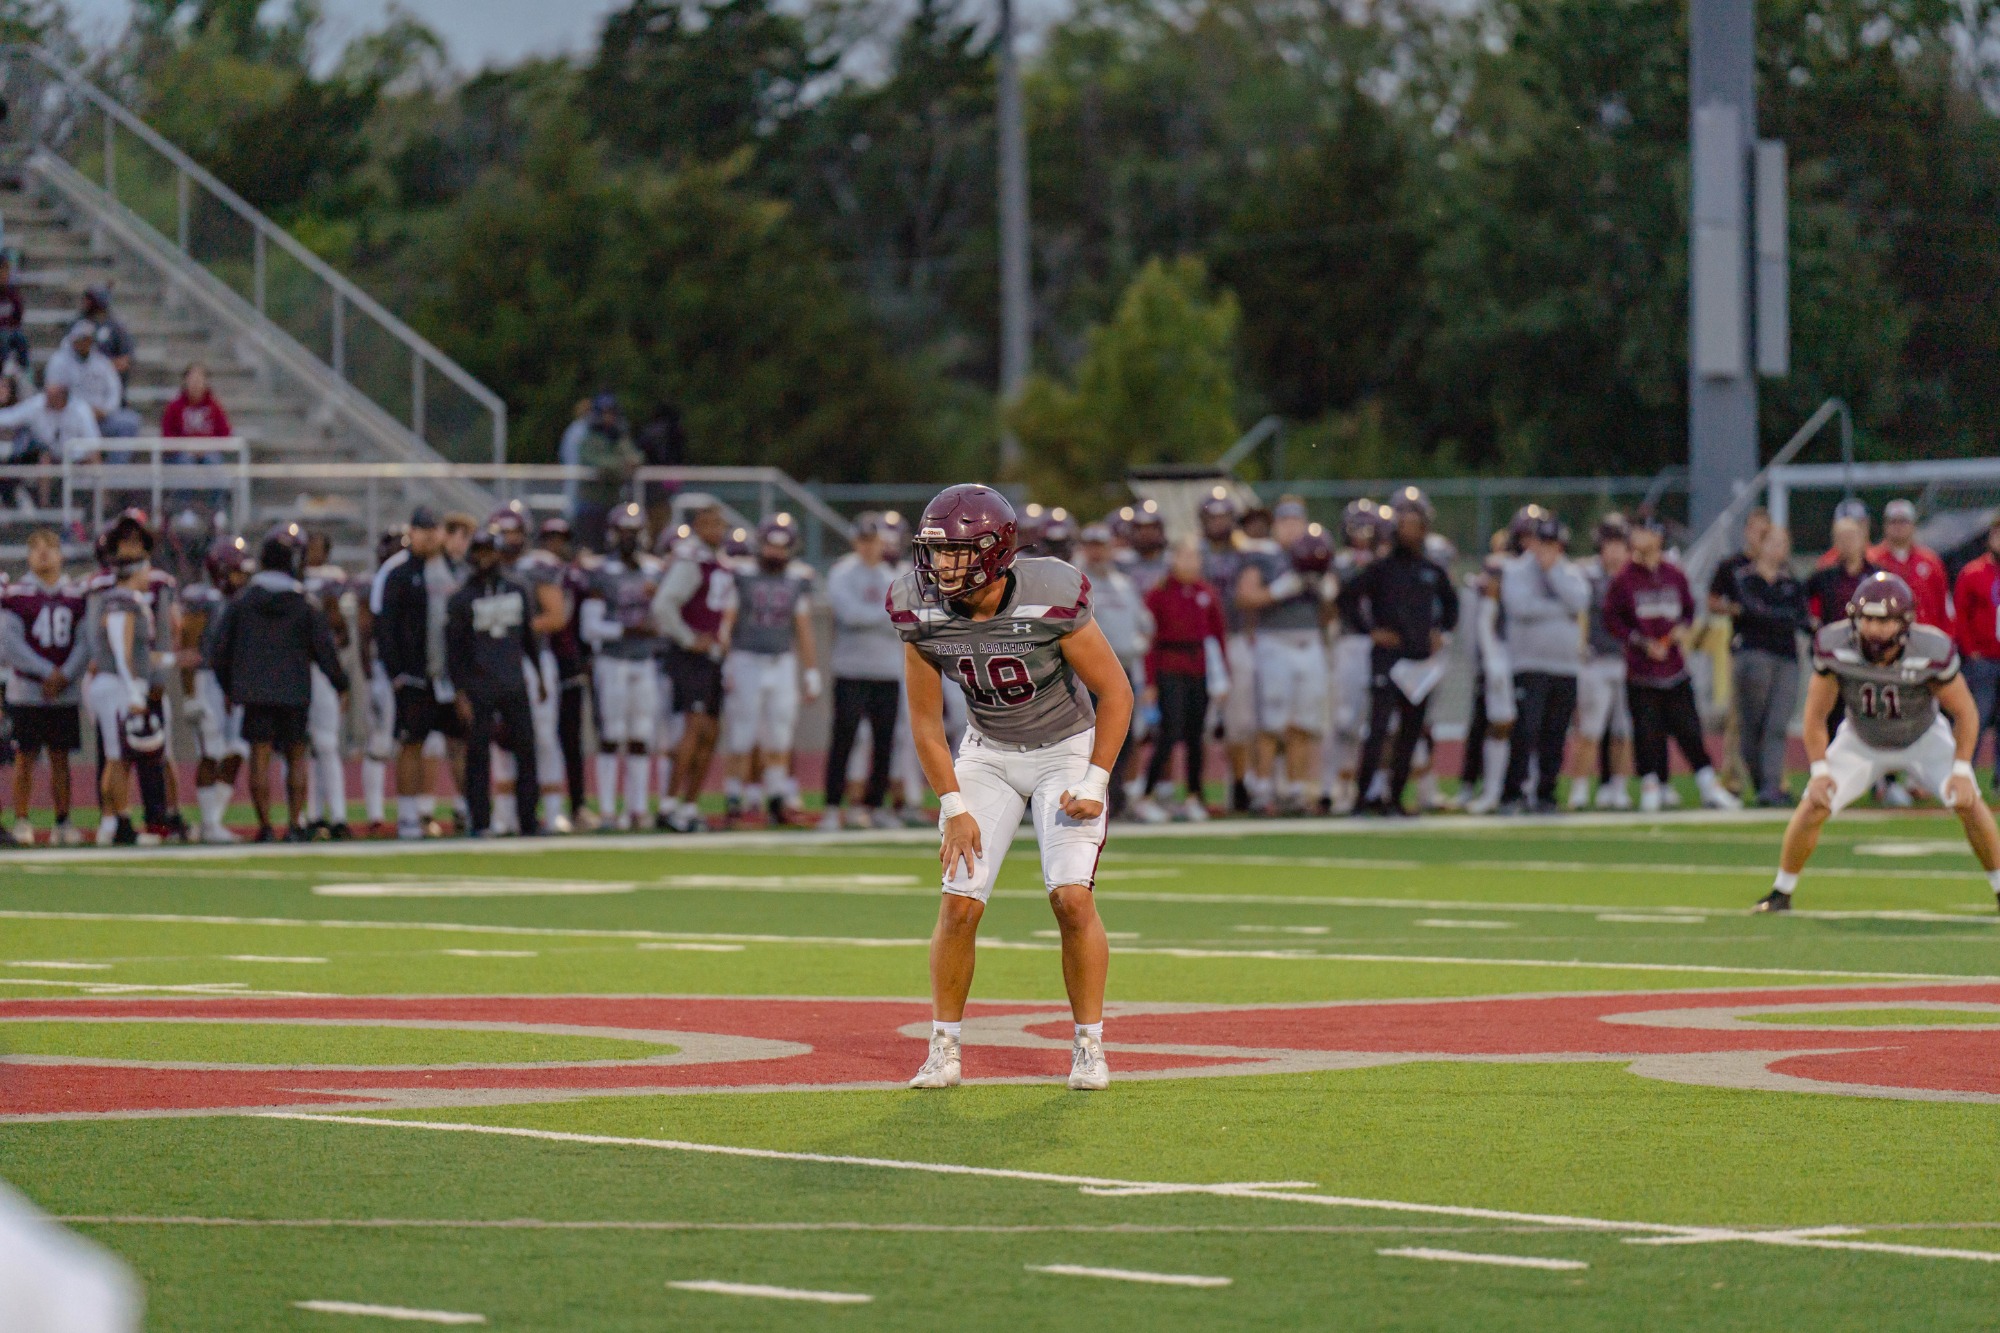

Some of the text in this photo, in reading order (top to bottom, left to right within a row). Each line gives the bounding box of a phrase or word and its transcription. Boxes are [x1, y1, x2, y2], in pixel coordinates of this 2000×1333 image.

[31, 604, 73, 648] 48
[934, 641, 1035, 655] FATHER ABRAHAM
[956, 655, 1038, 707] 18
[1858, 682, 1903, 720] 11
